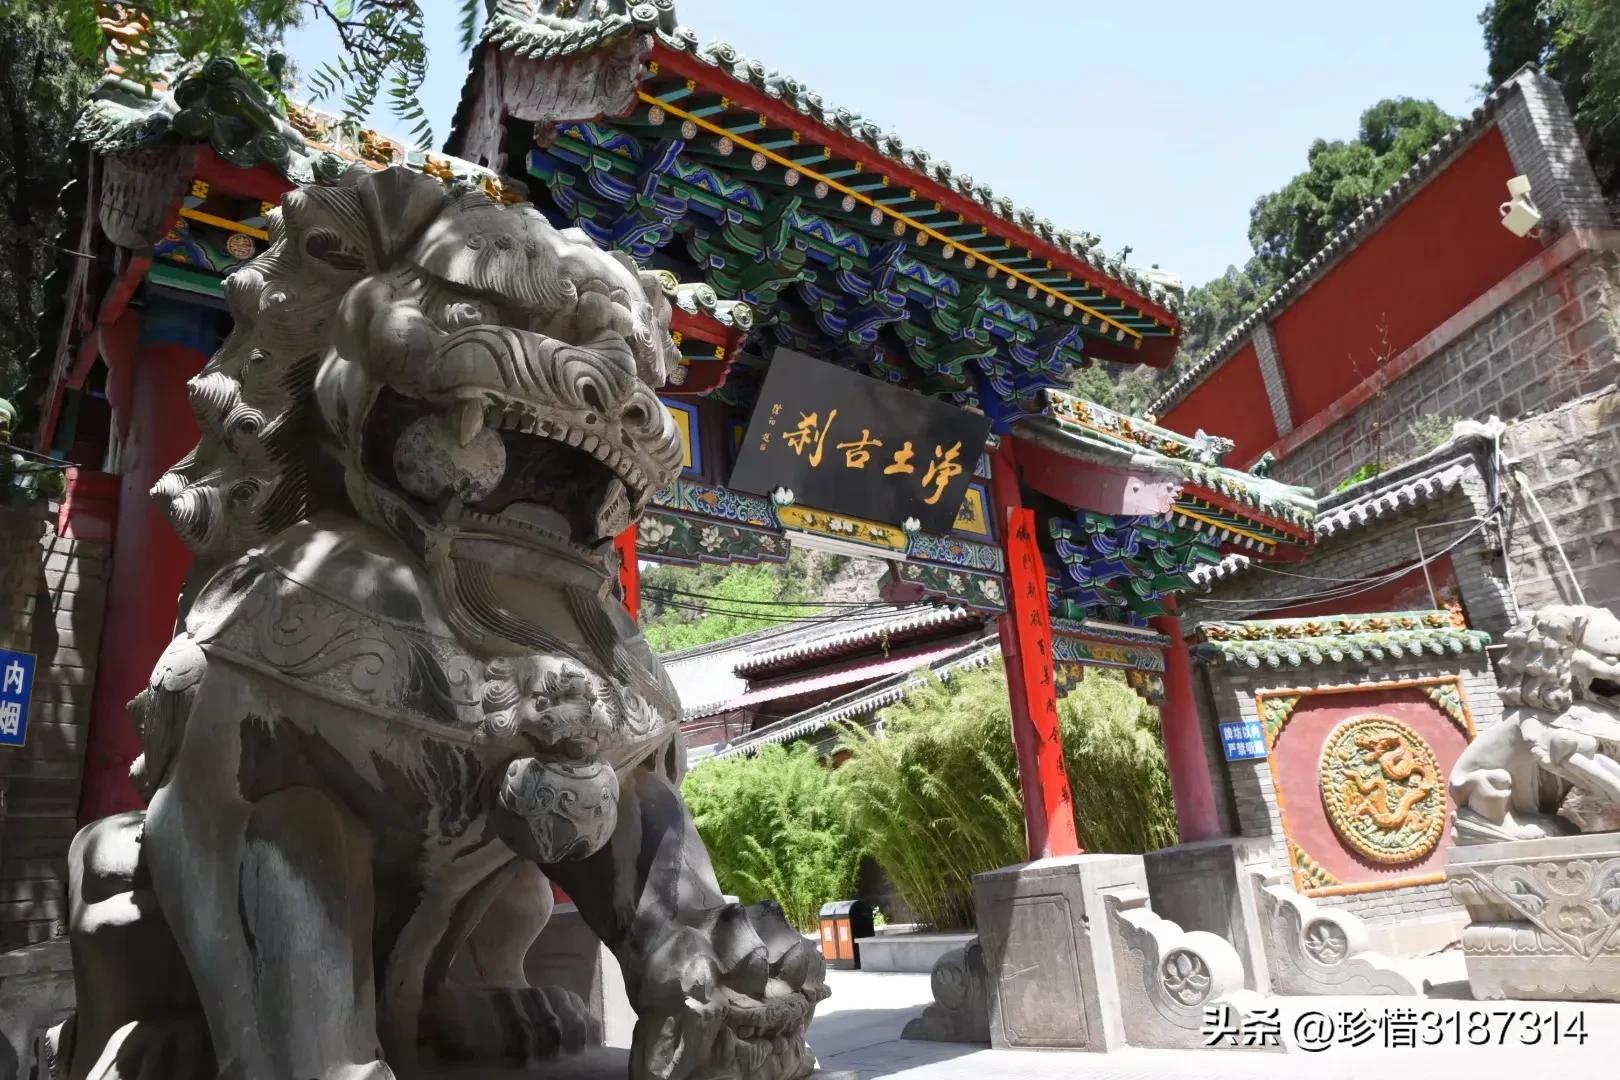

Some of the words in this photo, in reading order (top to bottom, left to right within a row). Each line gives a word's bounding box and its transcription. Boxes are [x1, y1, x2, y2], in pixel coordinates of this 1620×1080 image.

[3, 660, 25, 695] 内
[0, 699, 21, 736] 烟
[1227, 740, 1265, 757] 严禁吸
